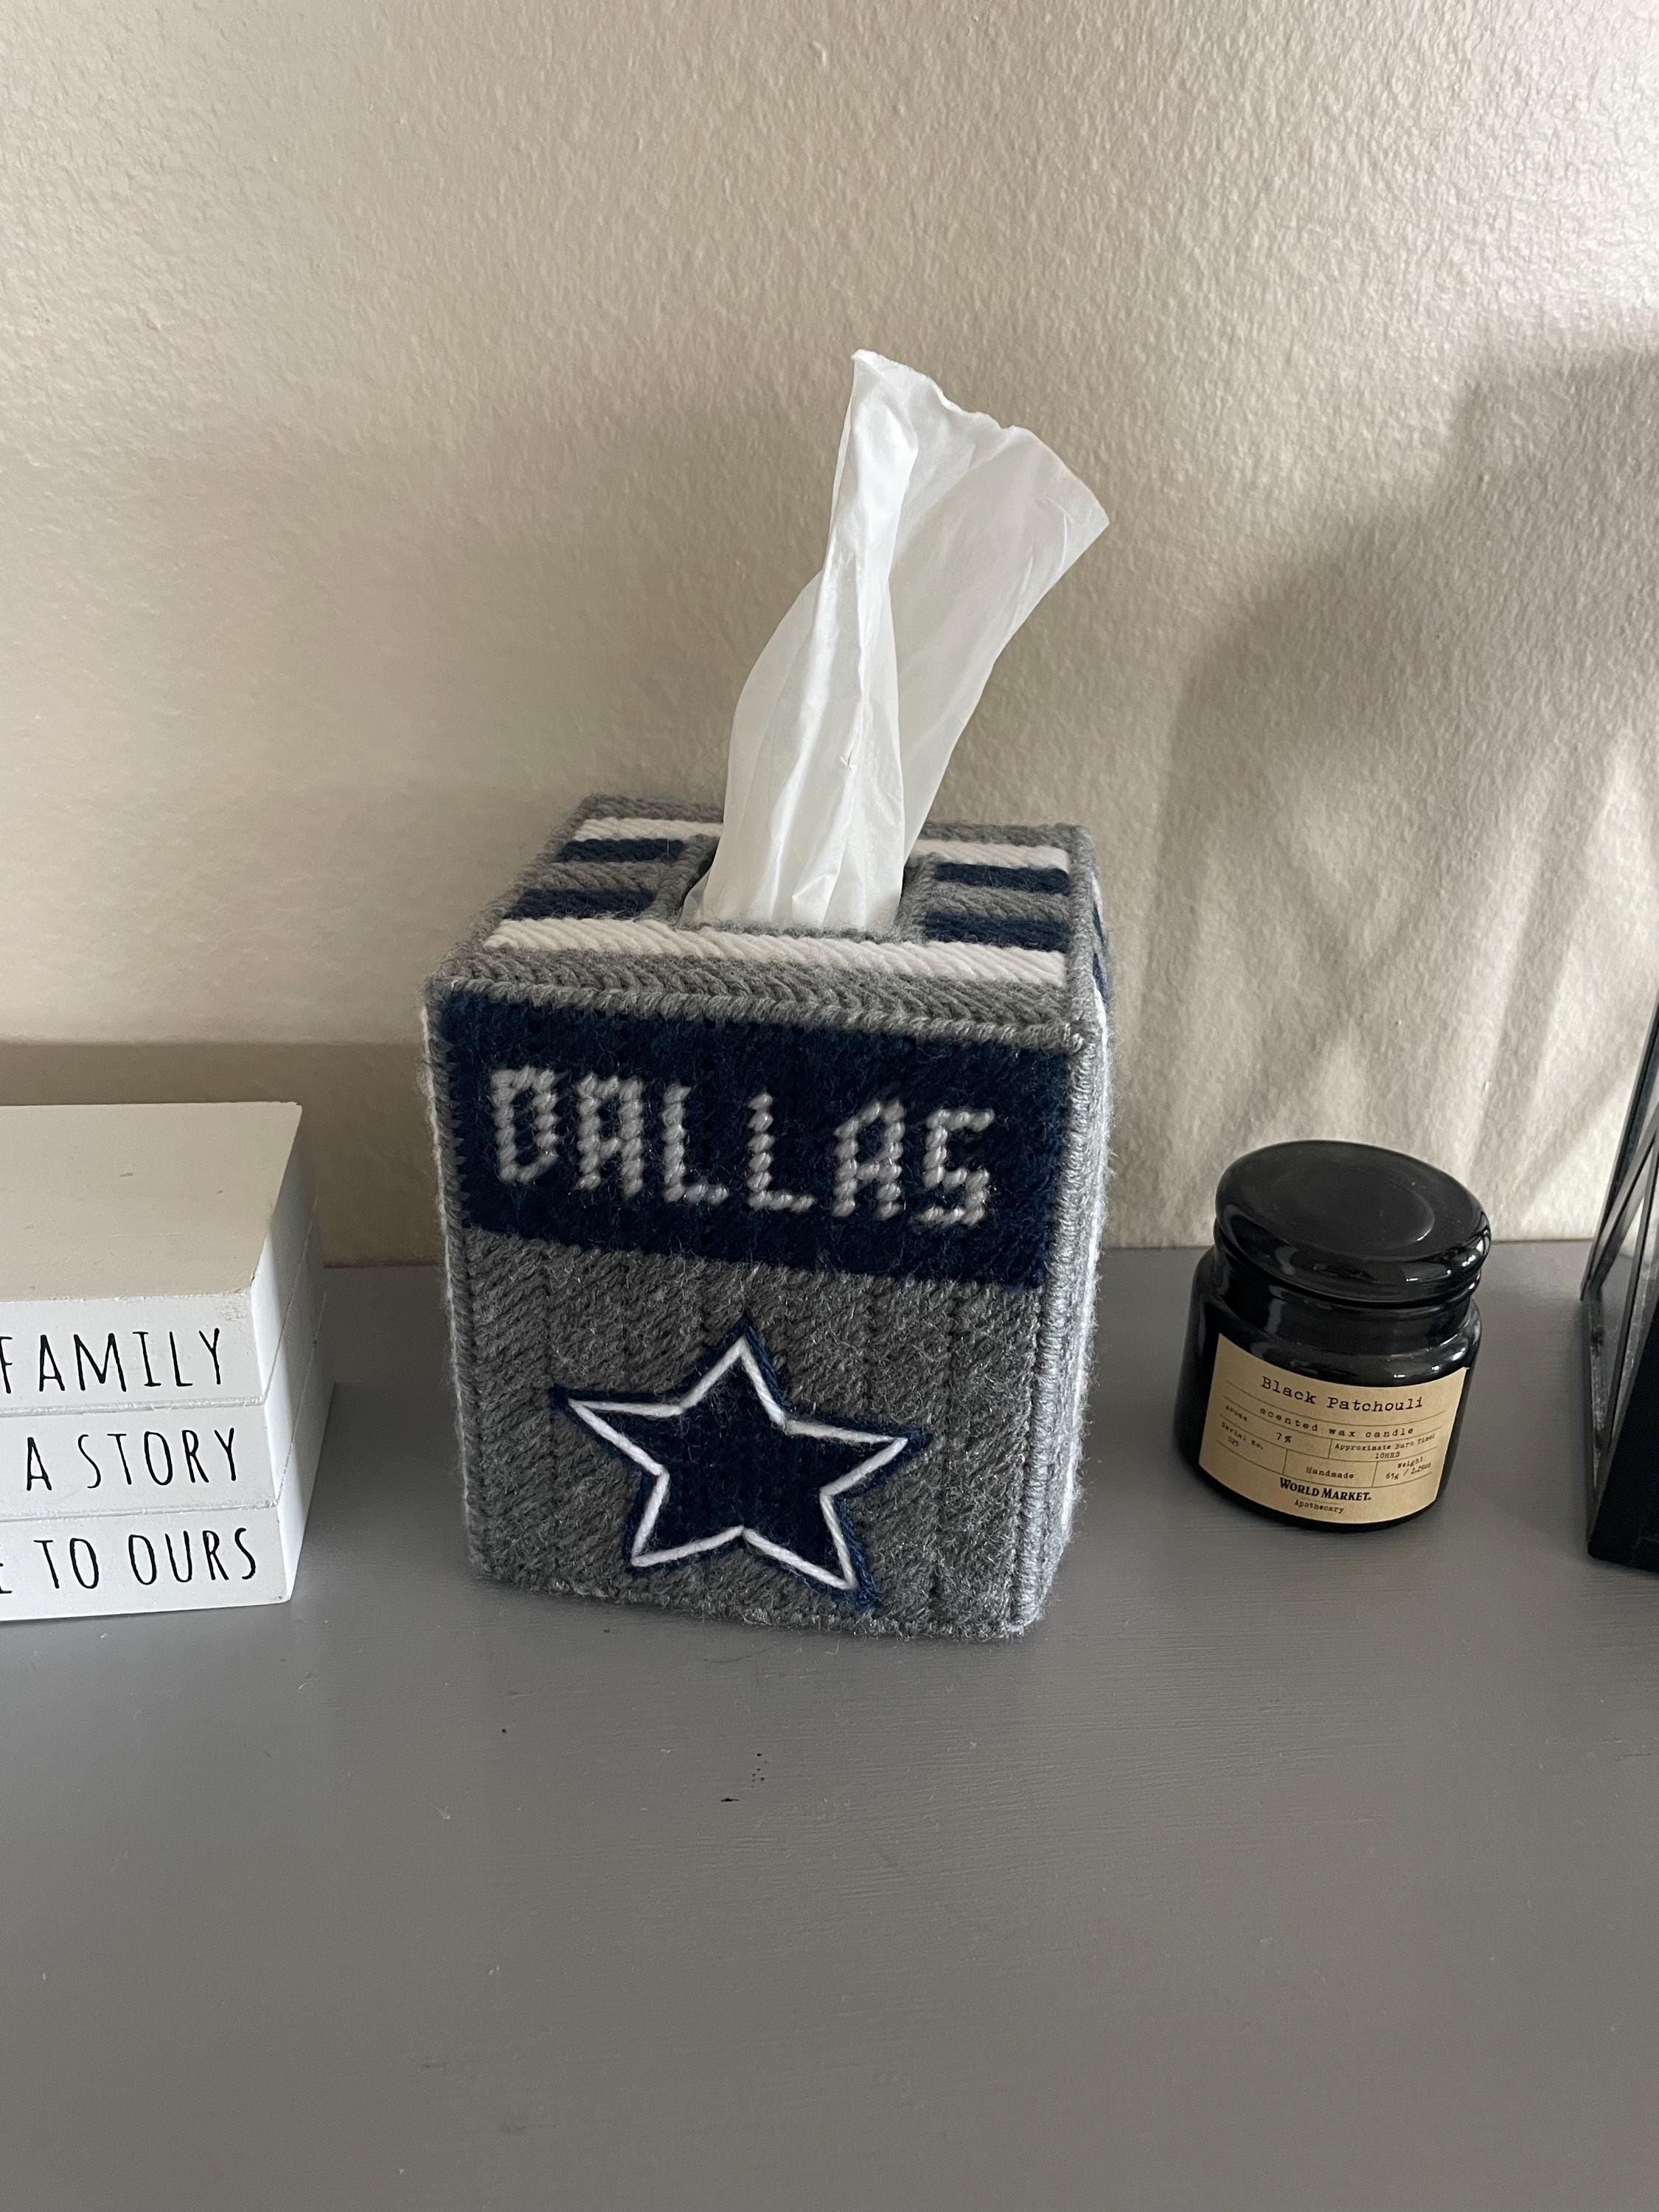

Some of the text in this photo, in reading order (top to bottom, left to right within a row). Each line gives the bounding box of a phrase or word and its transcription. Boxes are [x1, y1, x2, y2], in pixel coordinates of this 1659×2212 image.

[490, 1065, 995, 1228] DALLAS
[0, 1328, 220, 1394] FAMILY
[1260, 1376, 1423, 1412] Black Patchouli
[1259, 1408, 1413, 1438] scented wax candle
[27, 1427, 237, 1491] A STORY
[1335, 1443, 1391, 1451] Approximate
[1279, 1477, 1320, 1497] WORLD
[1306, 1467, 1354, 1479] Handmade
[1294, 1499, 1344, 1514] Apothecary
[33, 1537, 100, 1589] TO
[128, 1527, 256, 1586] OURS
